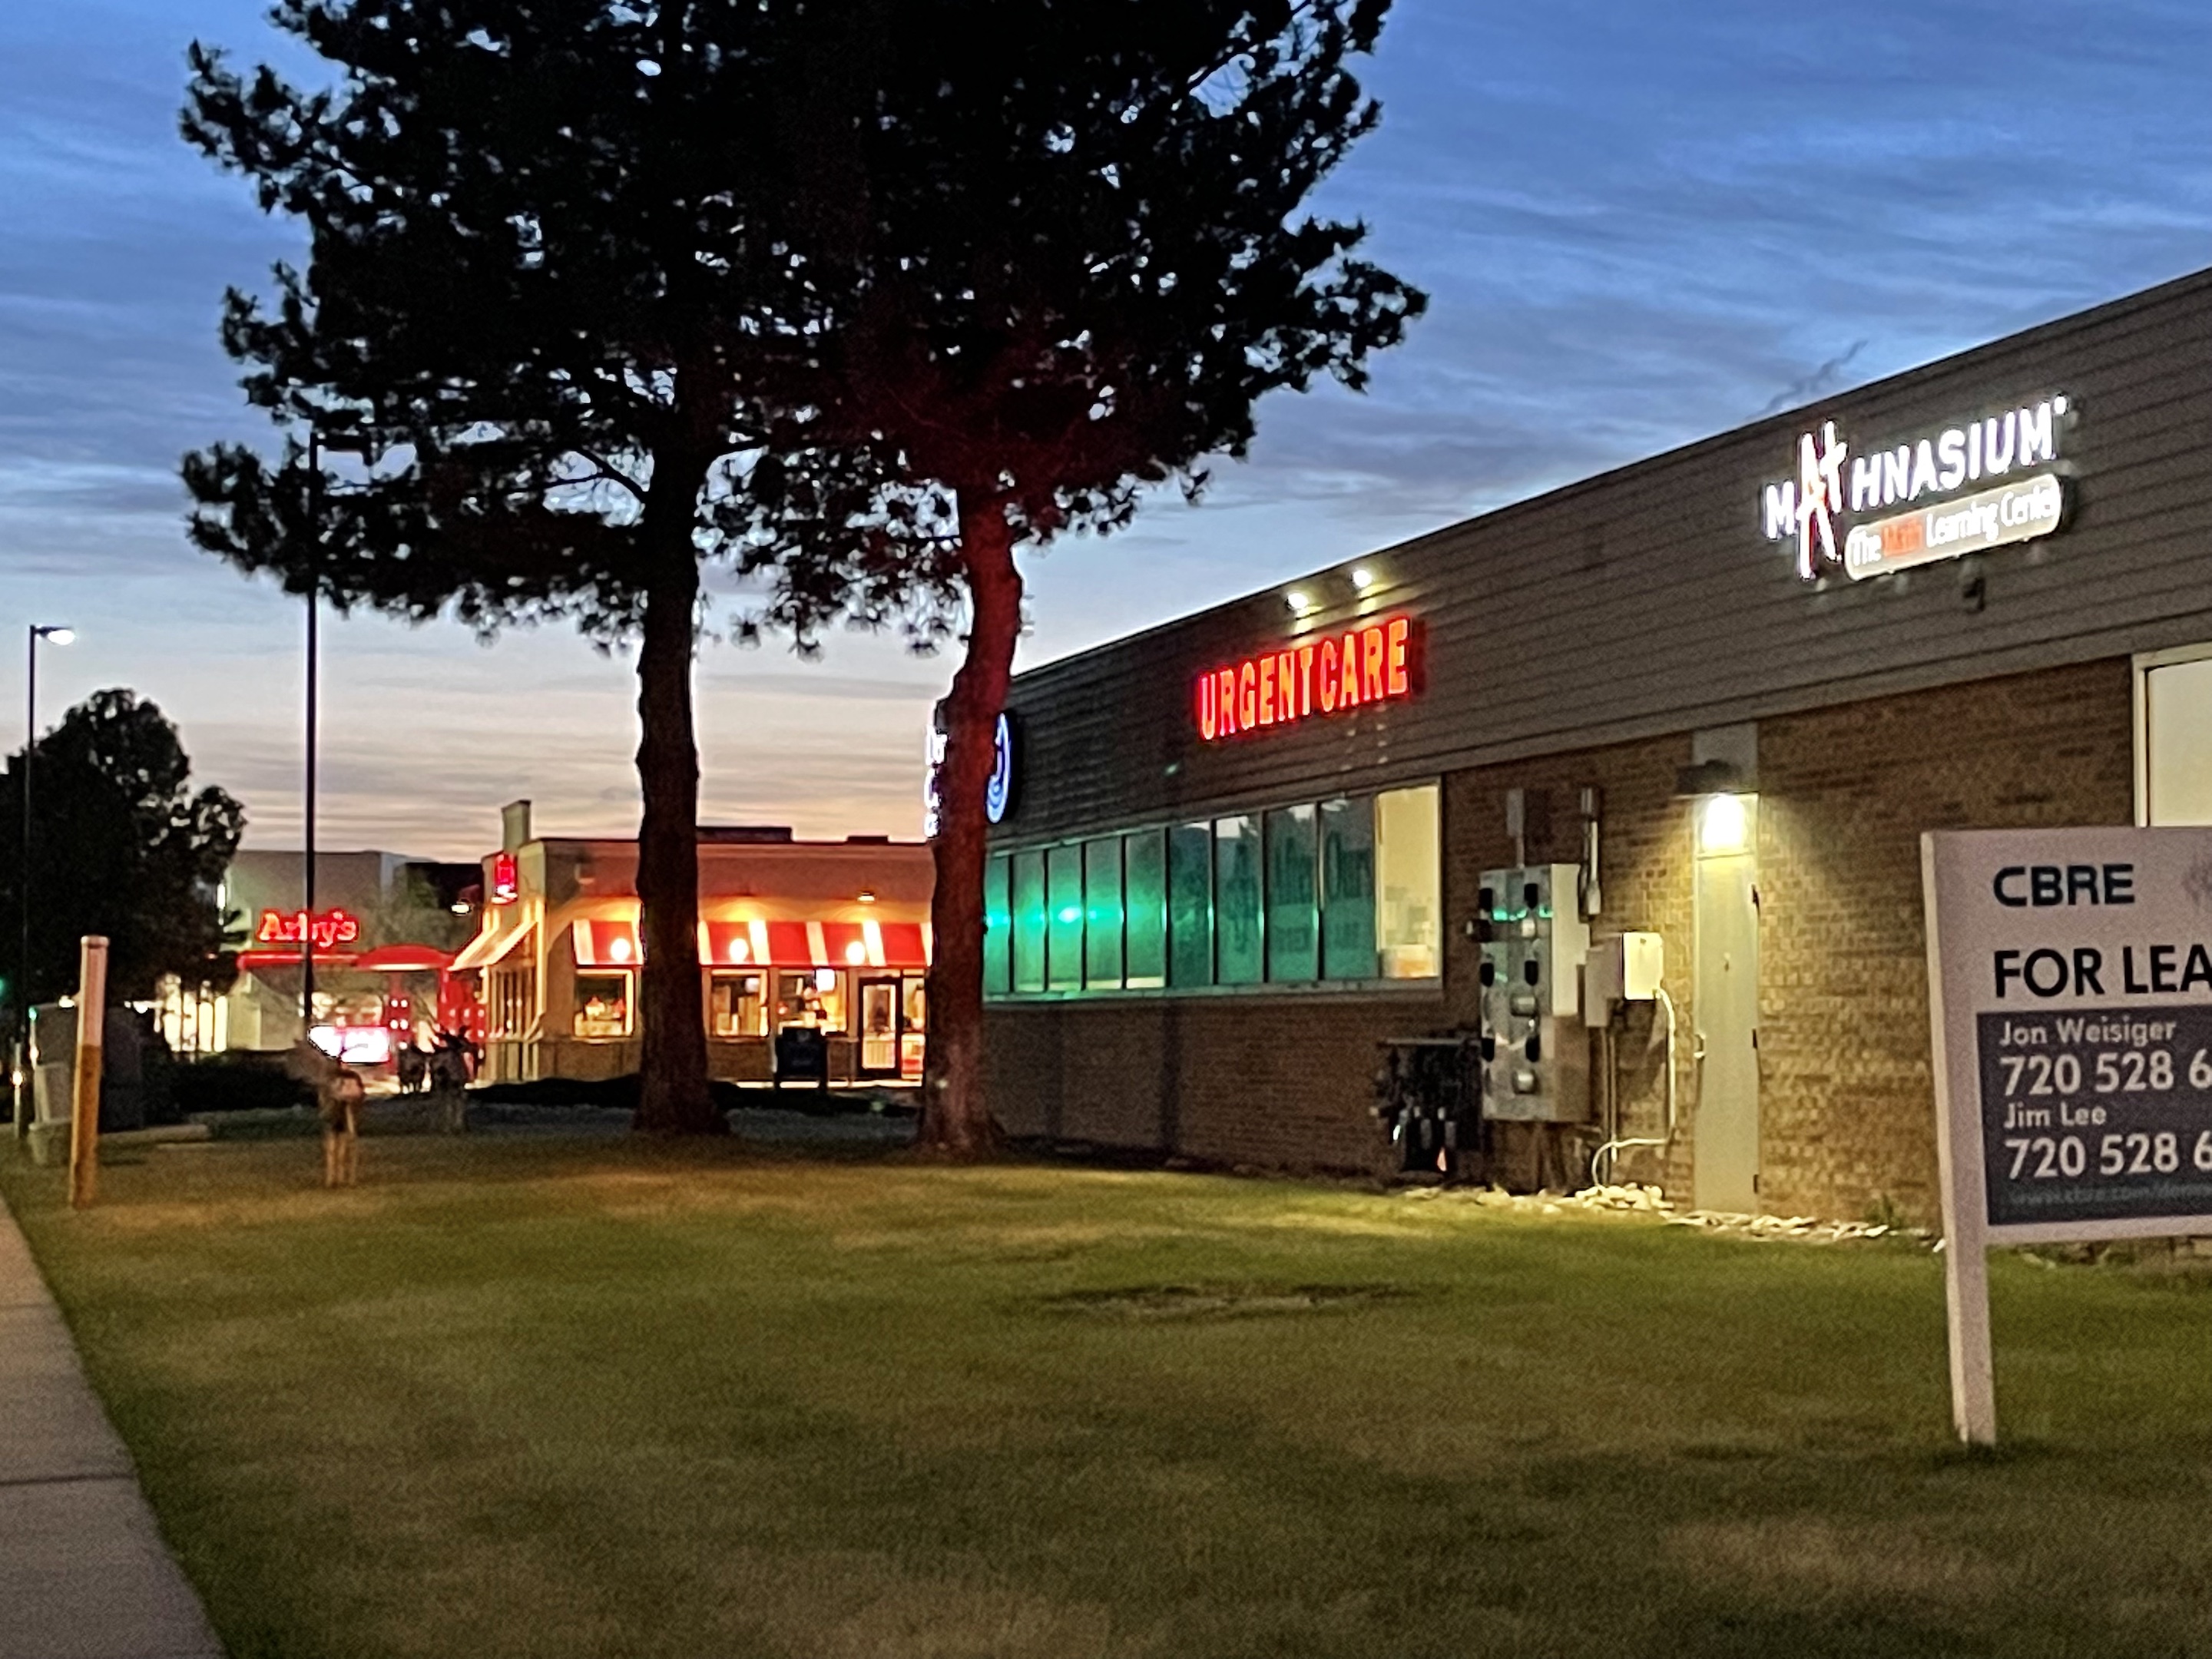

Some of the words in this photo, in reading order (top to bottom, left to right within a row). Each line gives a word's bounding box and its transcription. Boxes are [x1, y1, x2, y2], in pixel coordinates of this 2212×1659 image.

[1200, 646, 1313, 740] URGENT
[1319, 618, 1409, 713] CARE
[1993, 864, 2135, 907] CBRE
[1995, 949, 2105, 998] FOR
[1999, 1022, 2048, 1047] Jon
[2056, 1015, 2177, 1048] Weisiger
[2000, 1053, 2081, 1096] 720
[2095, 1050, 2174, 1092] 528
[2004, 1102, 2051, 1129] Jim
[2061, 1101, 2107, 1126] Lee
[2005, 1137, 2086, 1180] 720
[2099, 1131, 2180, 1177] 528
